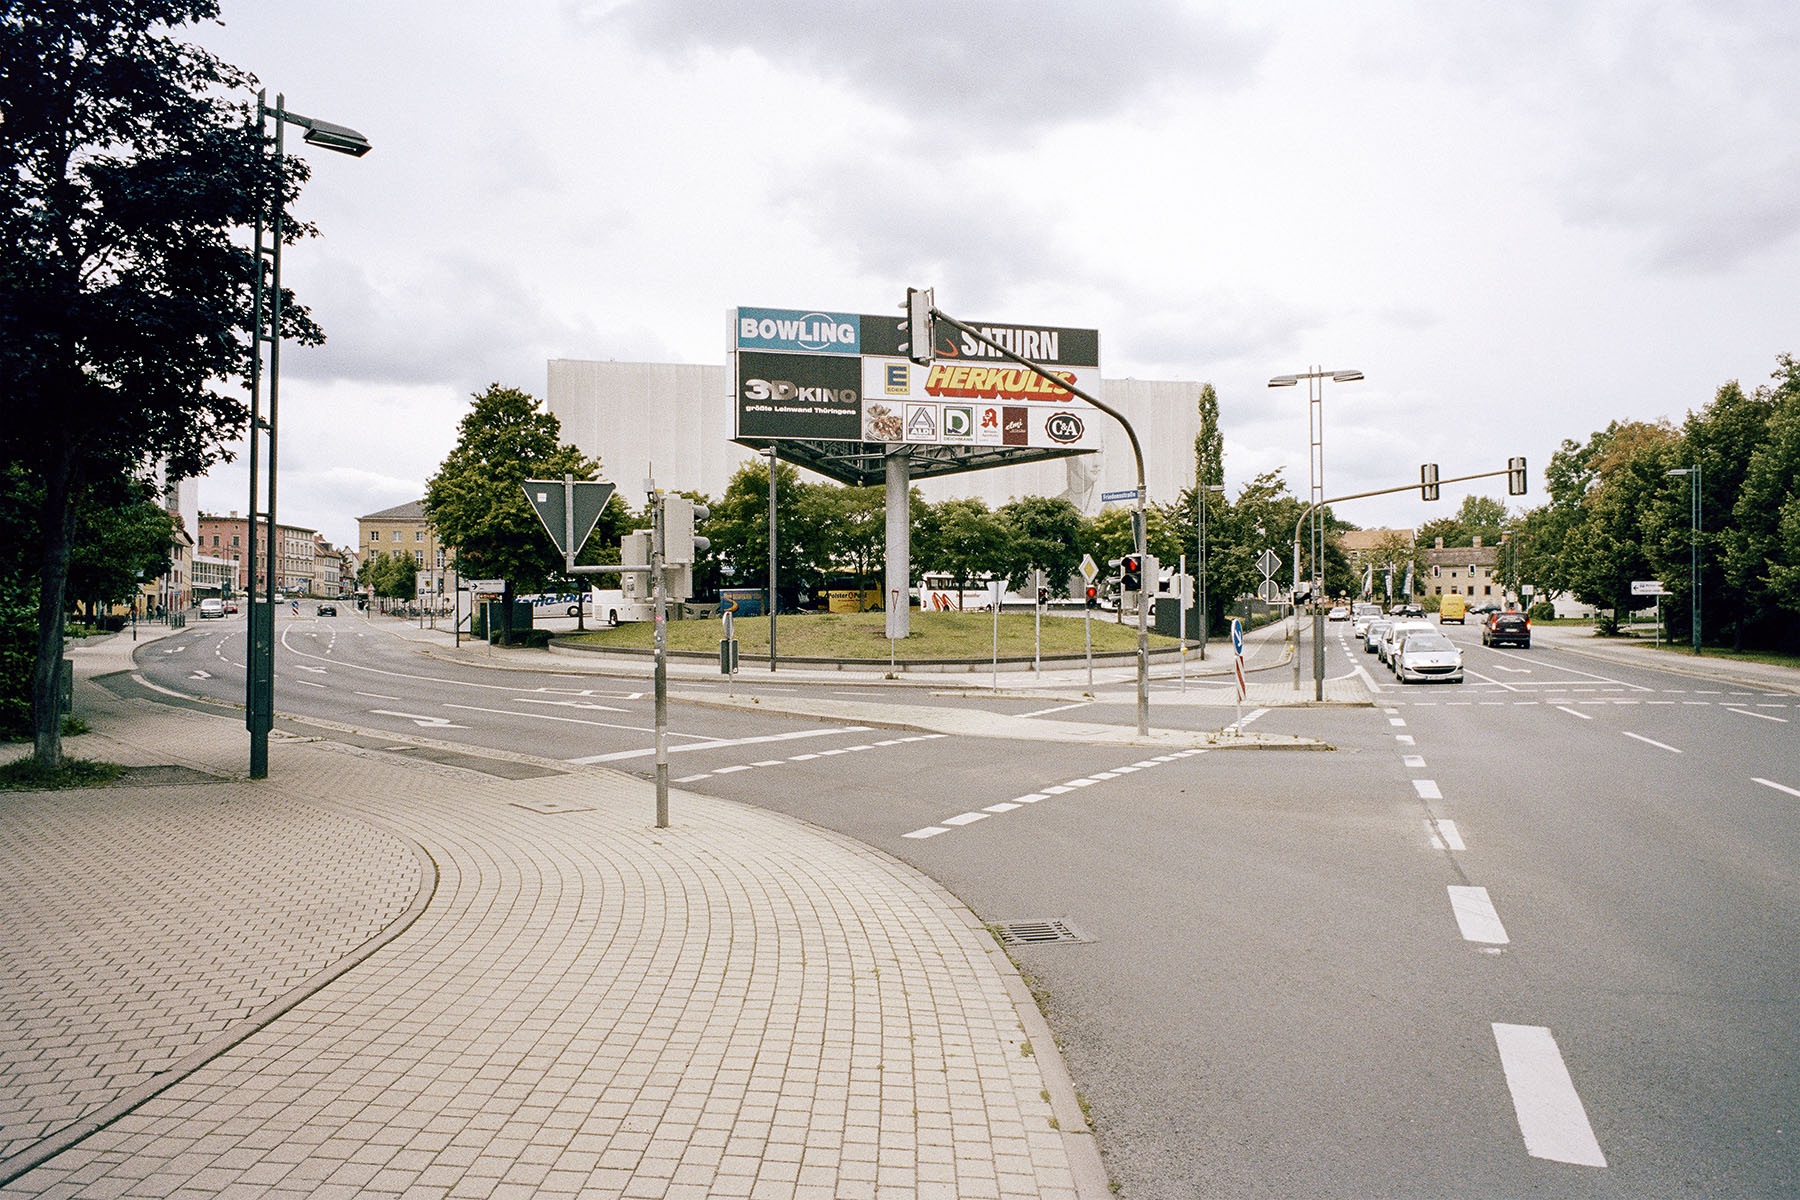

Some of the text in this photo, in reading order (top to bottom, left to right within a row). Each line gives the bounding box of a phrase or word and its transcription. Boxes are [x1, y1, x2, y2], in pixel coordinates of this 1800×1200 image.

[741, 318, 855, 344] BOWLING
[961, 325, 1059, 360] SATURN
[745, 379, 857, 404] 3D KINO
[925, 365, 1076, 400] HERKULES
[1051, 419, 1079, 436] C&A
